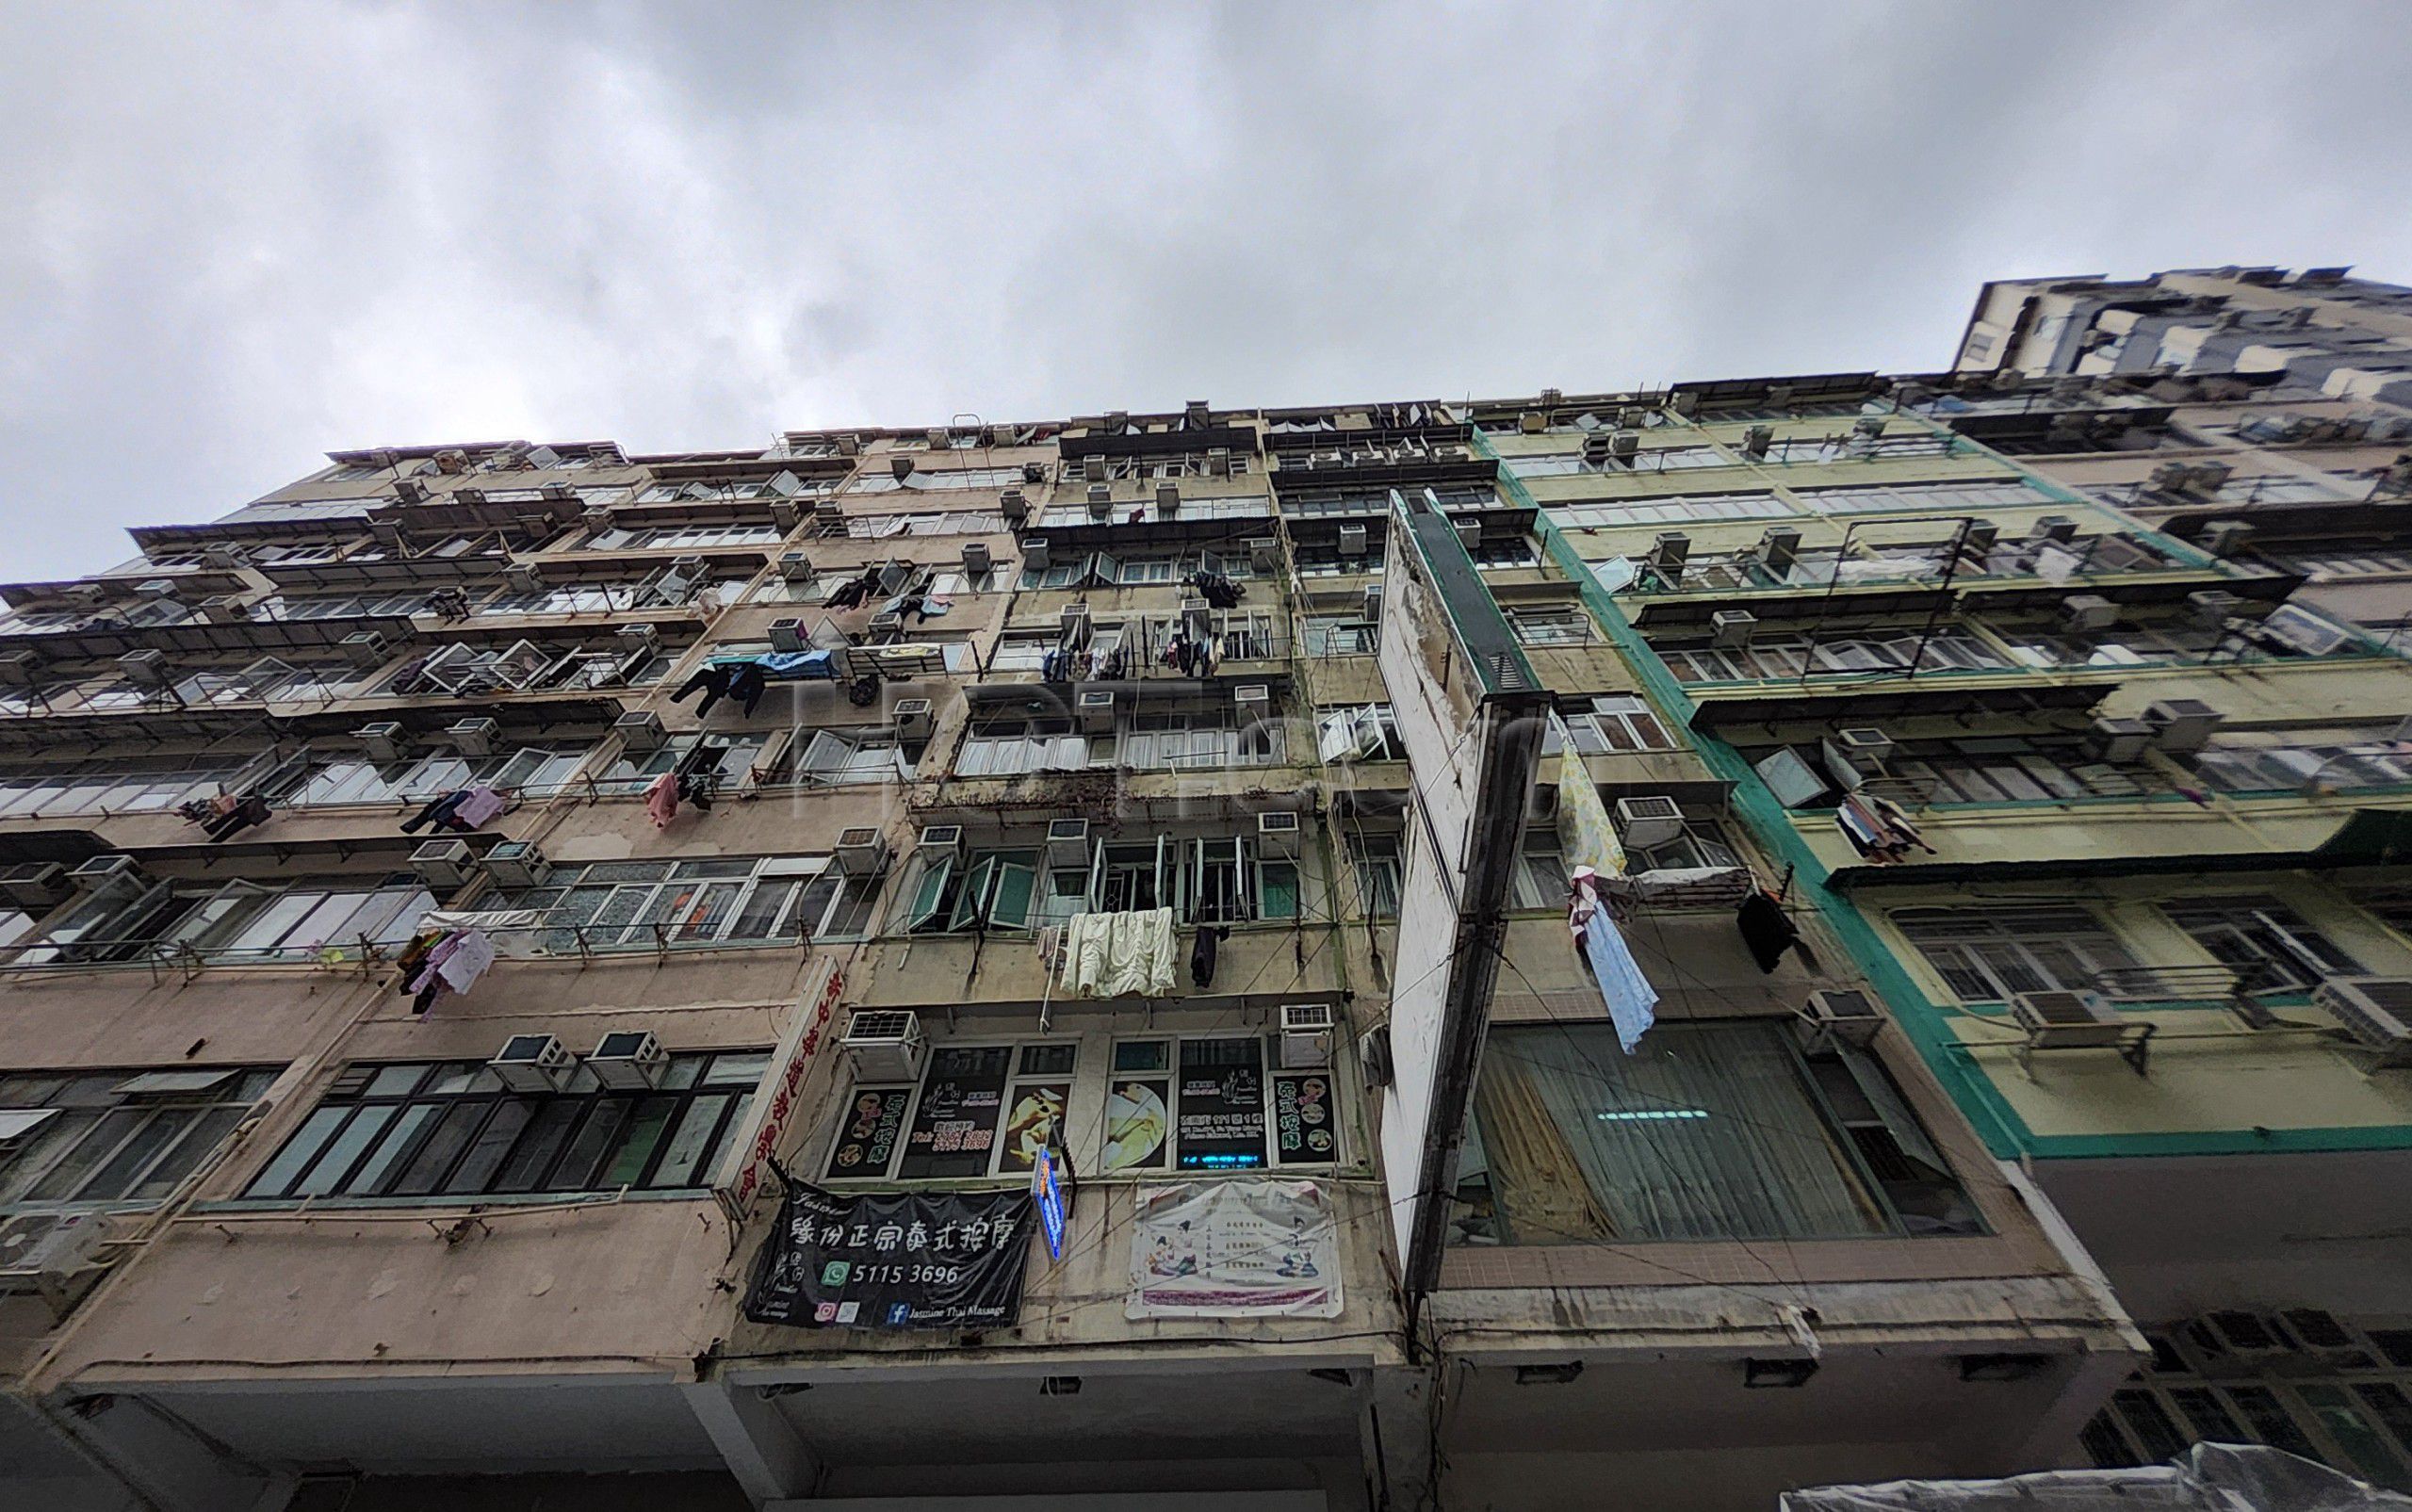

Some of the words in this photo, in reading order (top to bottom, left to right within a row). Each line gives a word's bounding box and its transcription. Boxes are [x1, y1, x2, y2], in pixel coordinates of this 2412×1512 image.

[790, 1214, 1016, 1252] 緣份正宗泰式按摩
[852, 1264, 903, 1284] 5115
[908, 1264, 959, 1284] 3696
